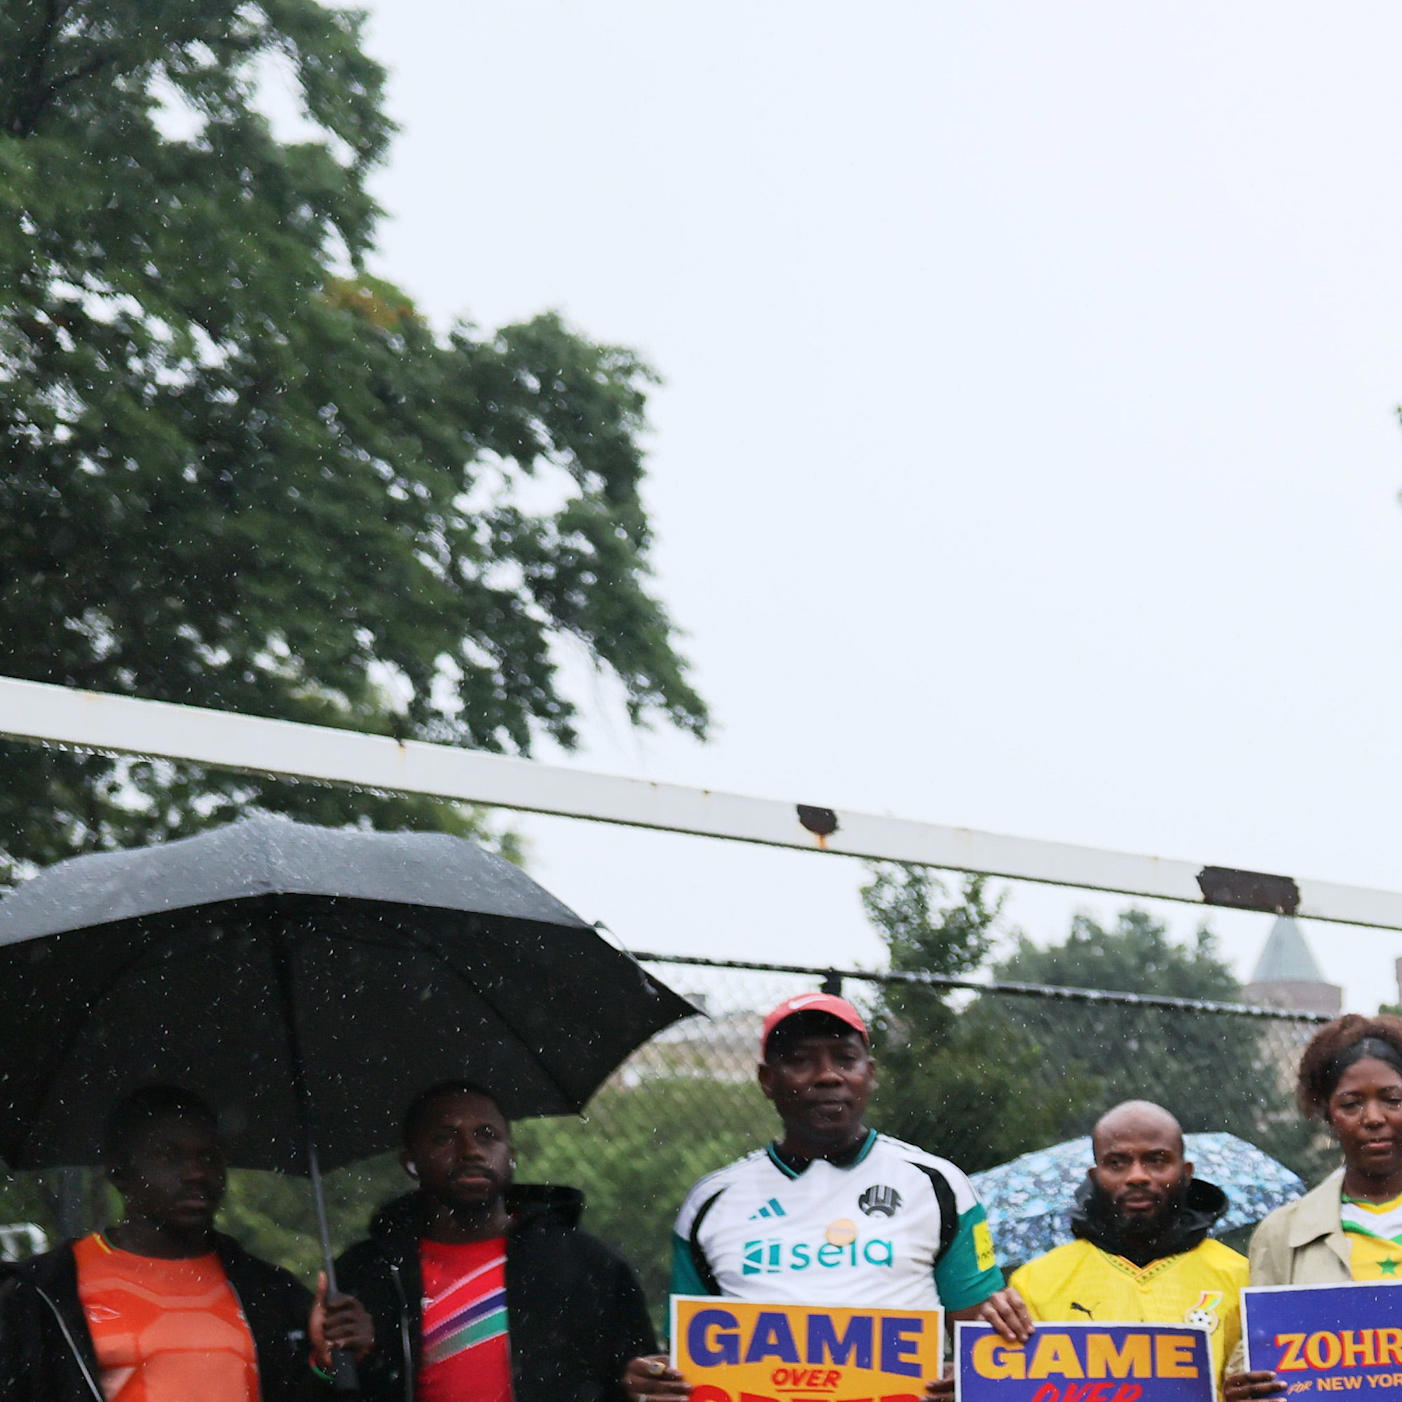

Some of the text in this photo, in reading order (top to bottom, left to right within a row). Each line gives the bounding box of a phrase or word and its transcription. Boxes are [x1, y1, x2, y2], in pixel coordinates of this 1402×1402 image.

[791, 1238, 893, 1270] sela
[687, 1309, 923, 1378] GAME
[972, 1334, 1199, 1380] GAME
[771, 1368, 842, 1388] OVER
[1287, 1380, 1313, 1395] FOR
[1316, 1375, 1363, 1391] NEW
